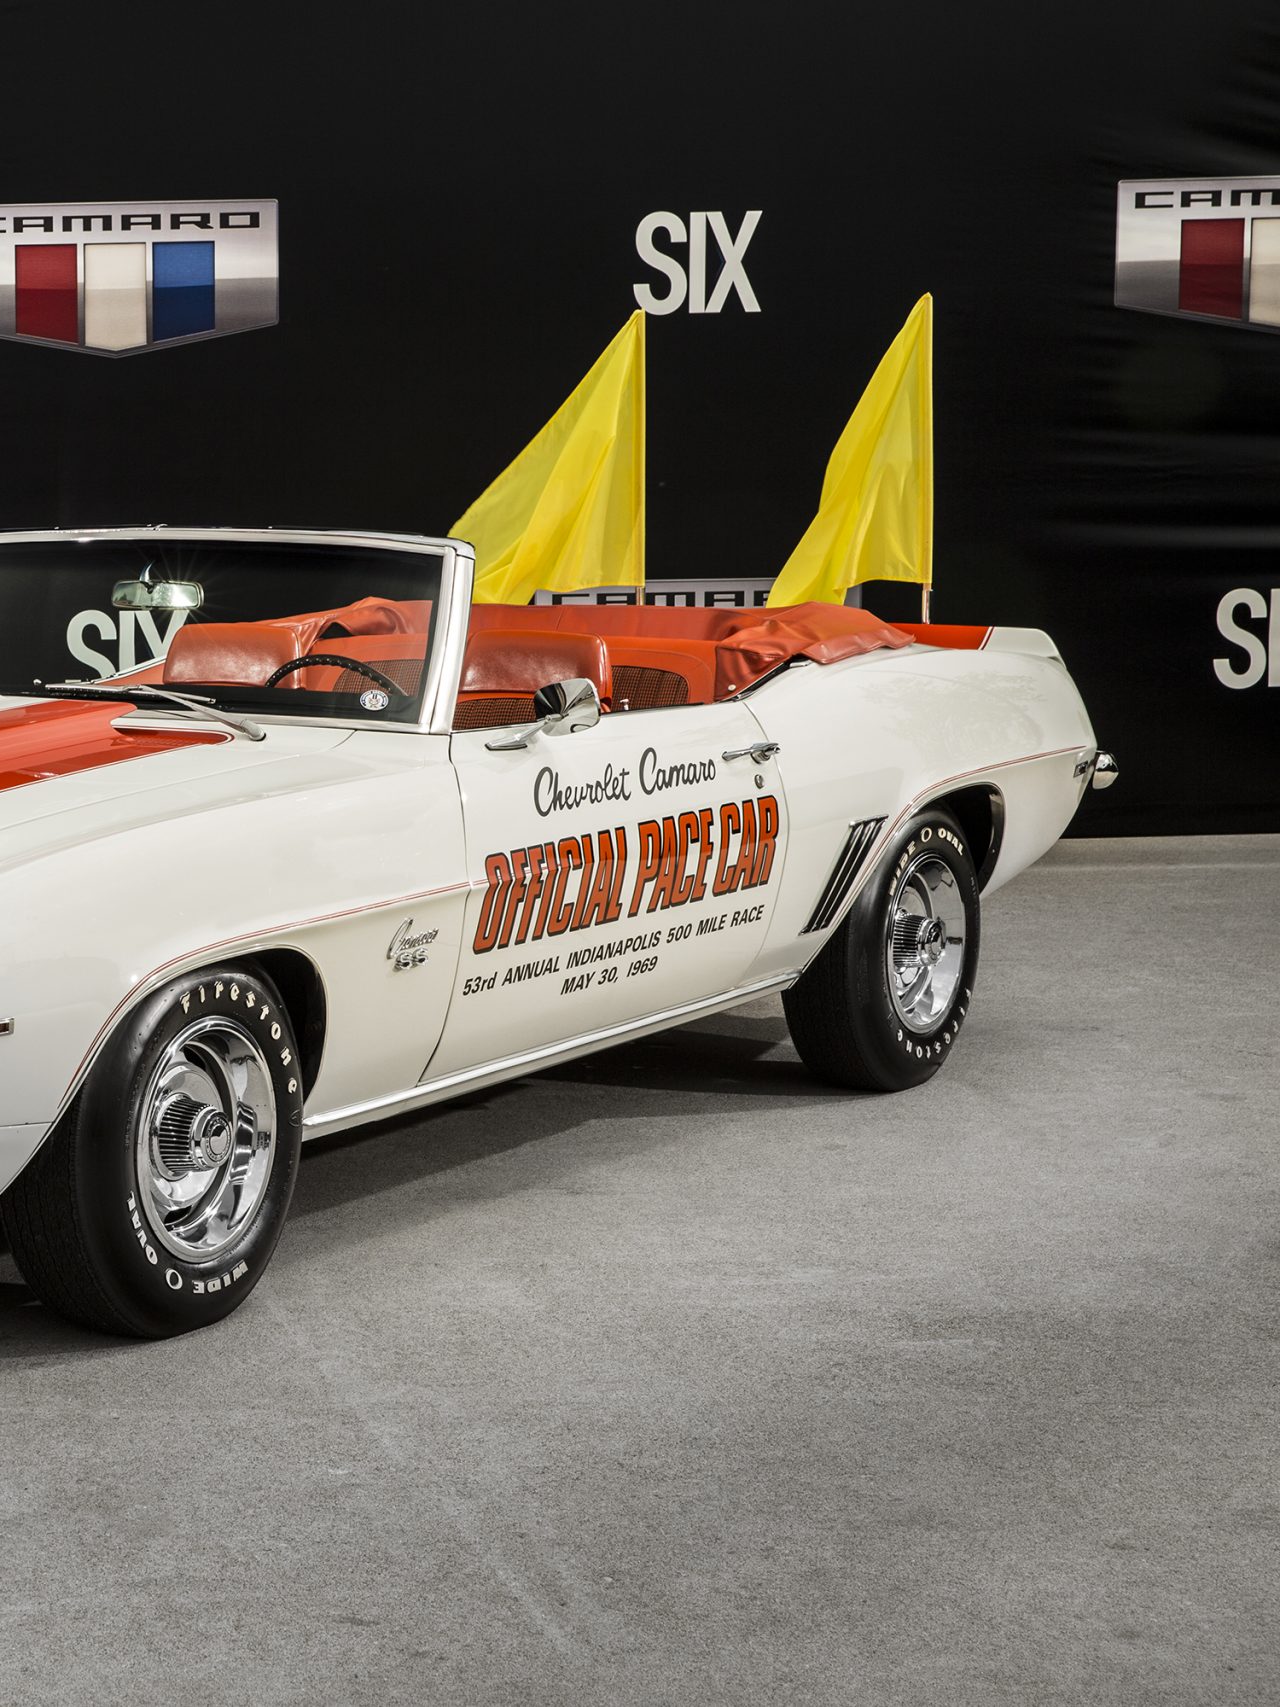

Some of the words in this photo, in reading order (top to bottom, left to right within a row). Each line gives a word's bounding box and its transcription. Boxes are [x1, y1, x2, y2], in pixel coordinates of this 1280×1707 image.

[1134, 189, 1280, 209] CAM
[632, 210, 763, 316] SIX
[552, 591, 771, 607] CAMA
[1212, 587, 1280, 690] SI
[533, 762, 631, 817] Chevrolet
[638, 747, 716, 795] Camaro
[472, 825, 627, 955] OFFICIAL
[627, 807, 715, 919] PACE
[713, 794, 779, 897] CAR
[395, 947, 429, 971] SS
[462, 971, 498, 996] 53rd
[501, 956, 560, 987] ANNUAL
[566, 930, 662, 969] INDIANAPOLIS
[666, 923, 693, 944] 500
[695, 914, 728, 937] MILE
[730, 904, 765, 928] RACE
[560, 971, 596, 996] MAY
[597, 966, 619, 985] 30,
[626, 955, 659, 978] 1969
[127, 1191, 159, 1266] OVAL
[192, 1259, 249, 1295] WIDE
